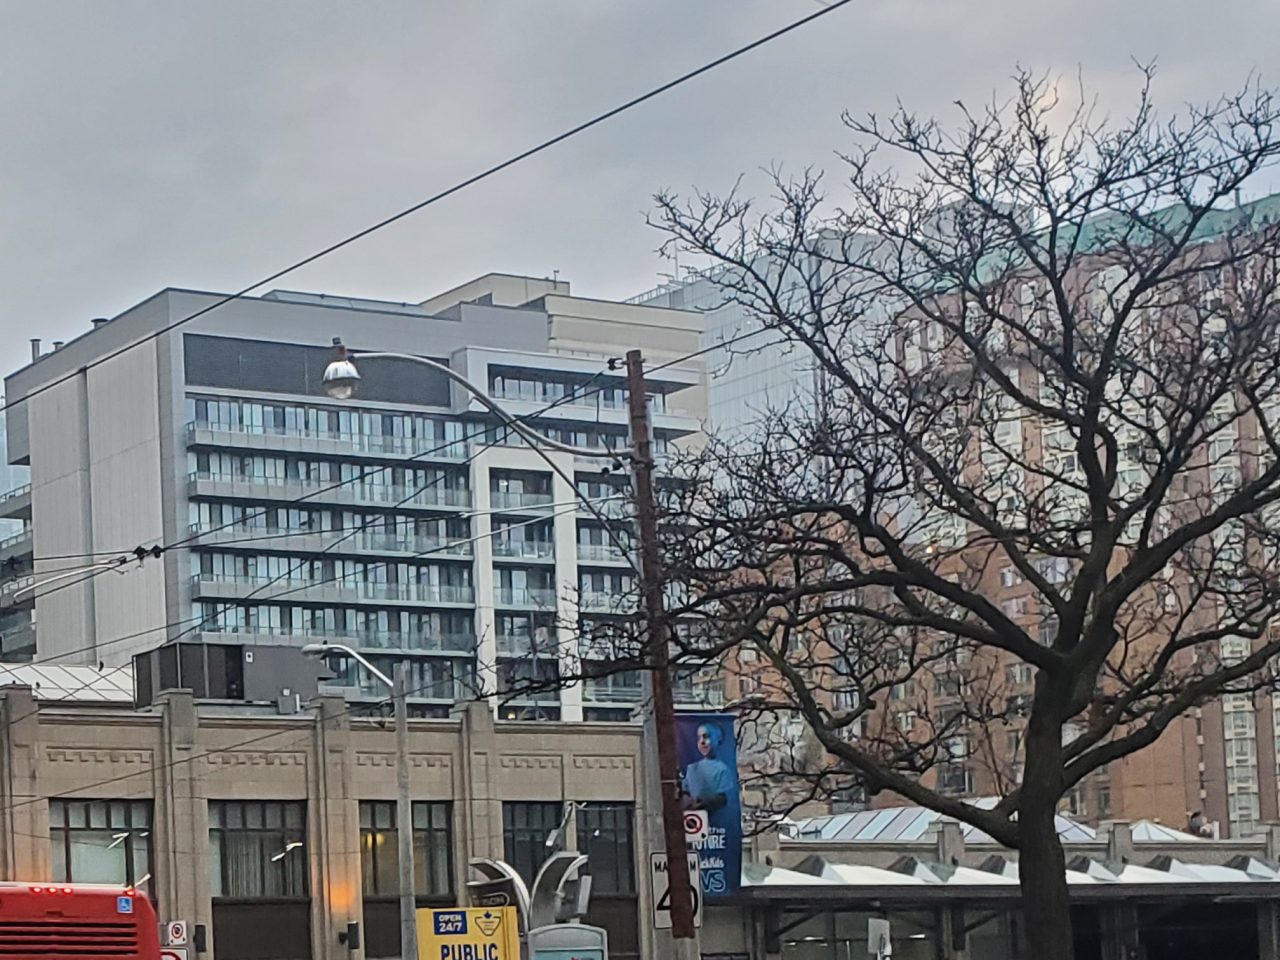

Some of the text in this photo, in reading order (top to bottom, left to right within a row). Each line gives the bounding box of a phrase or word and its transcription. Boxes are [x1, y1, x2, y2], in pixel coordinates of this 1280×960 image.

[700, 857, 725, 869] ickKids
[439, 914, 462, 922] OPEN
[439, 922, 462, 932] 24/7
